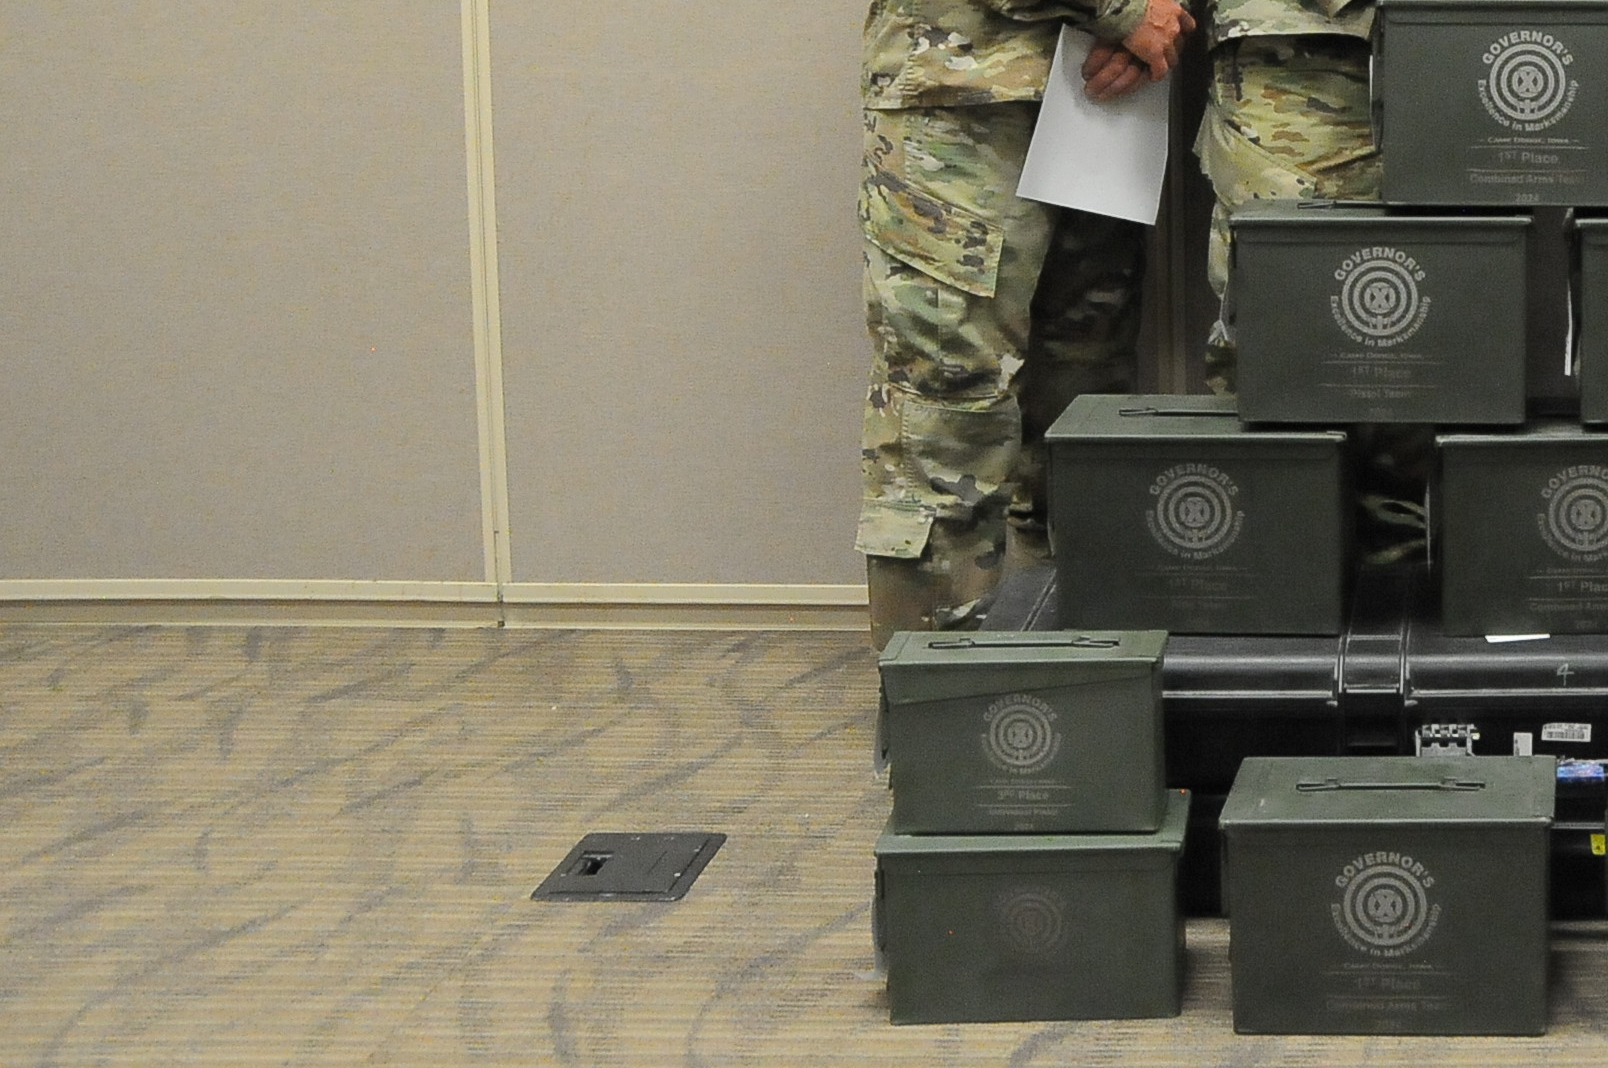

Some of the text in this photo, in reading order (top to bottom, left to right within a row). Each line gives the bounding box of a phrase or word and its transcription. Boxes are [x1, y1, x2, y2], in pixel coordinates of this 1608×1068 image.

[1482, 30, 1574, 66] GOVERNOR'S
[1477, 79, 1511, 127] Excellence
[1524, 80, 1579, 131] Marksmanship
[1521, 151, 1559, 164] Place
[1334, 247, 1426, 281] GOVERNOR'S
[1149, 463, 1239, 495] GOVERNOR'S
[1557, 663, 1575, 686] 4
[1335, 851, 1435, 888] GOVERNOR'S
